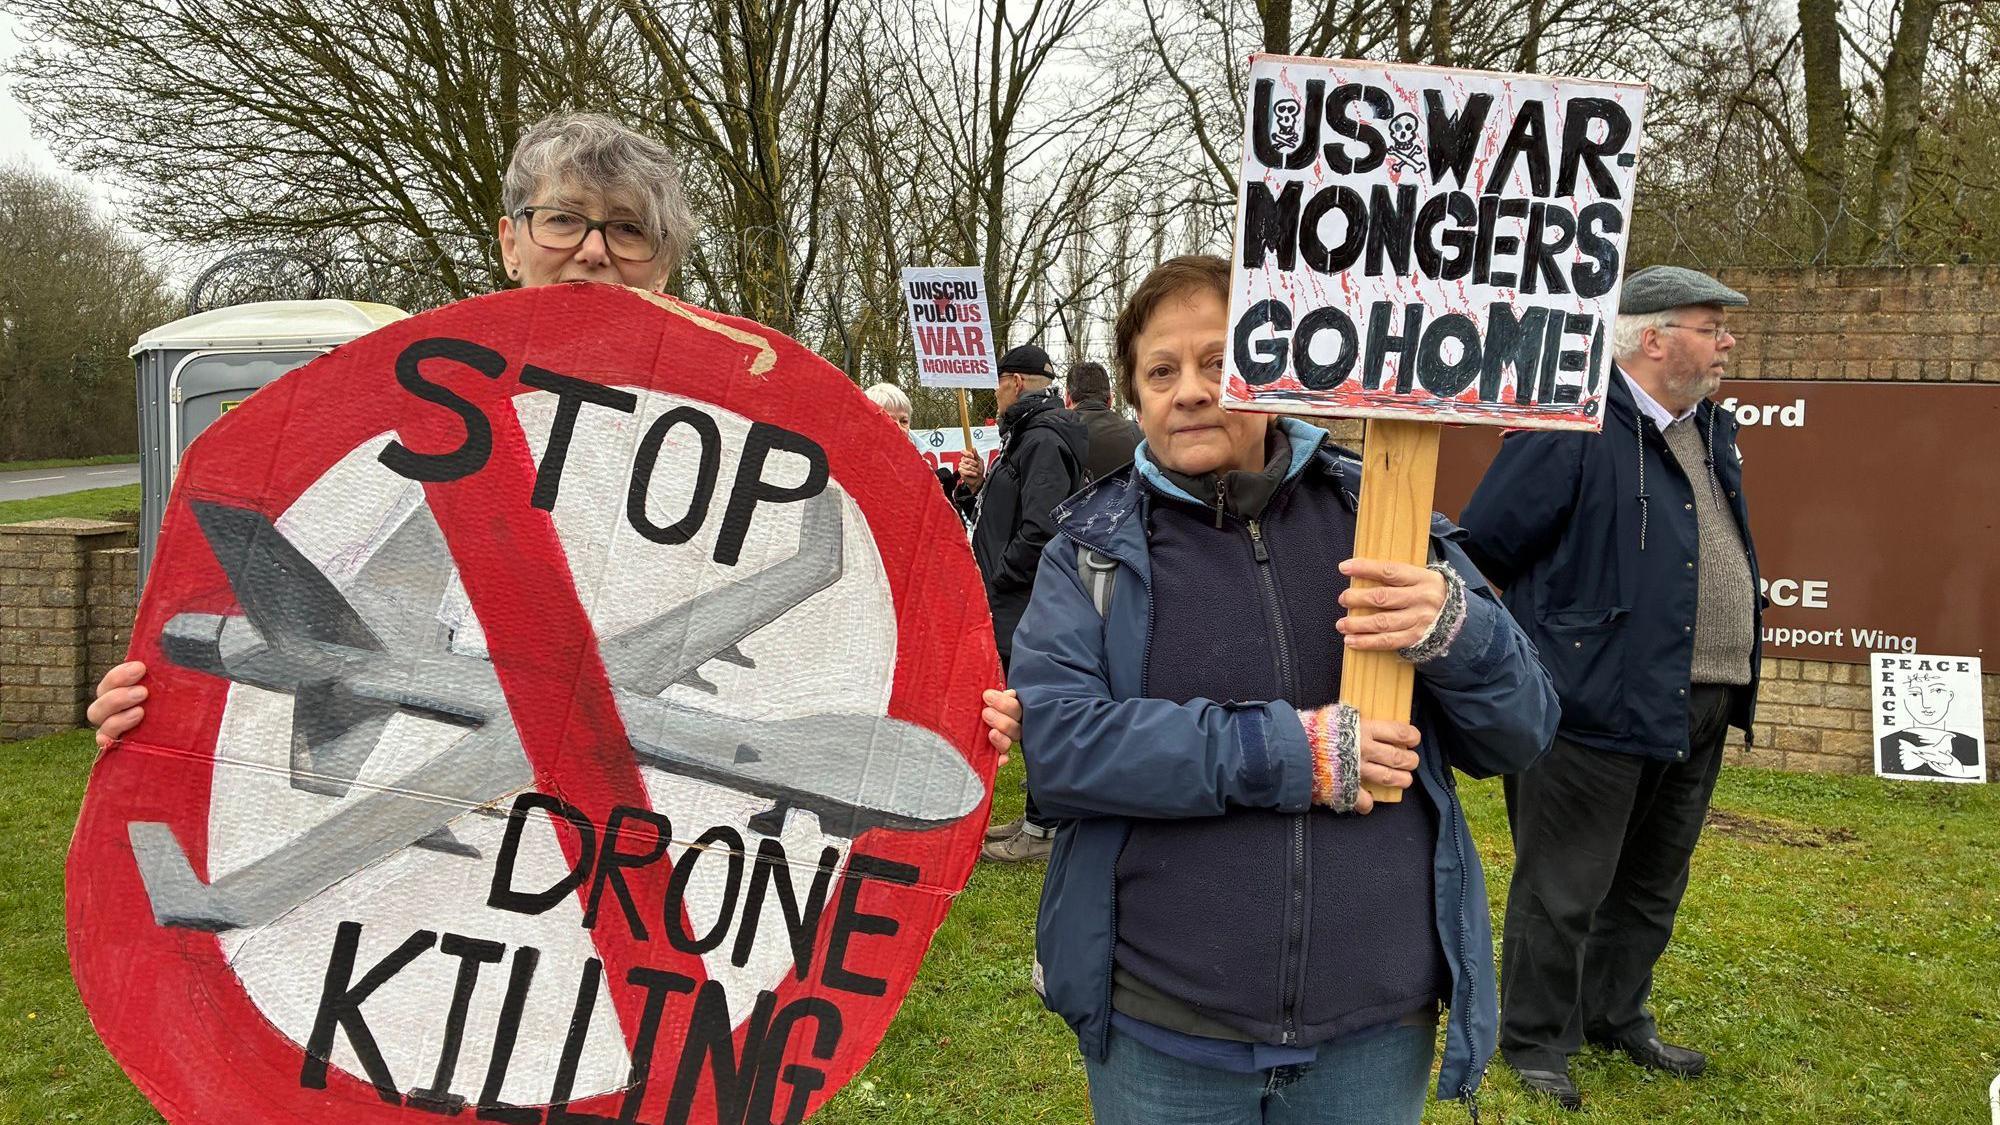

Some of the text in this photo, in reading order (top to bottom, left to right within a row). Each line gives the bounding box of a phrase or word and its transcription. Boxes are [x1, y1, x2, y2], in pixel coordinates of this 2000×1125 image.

[1251, 78, 1395, 175] US
[1242, 180, 1625, 299] MONGERS
[908, 281, 978, 301] UNSCRU
[913, 303, 982, 323] PULOUS
[916, 326, 986, 357] WAR
[922, 358, 990, 375] MONGERS
[1233, 298, 1606, 417] GO HOME!
[376, 336, 830, 567] STOP
[1850, 628, 1917, 654] Wing
[1881, 658, 1970, 673] PEACE
[486, 792, 922, 997] DRONE
[300, 920, 844, 1125] KILLING
